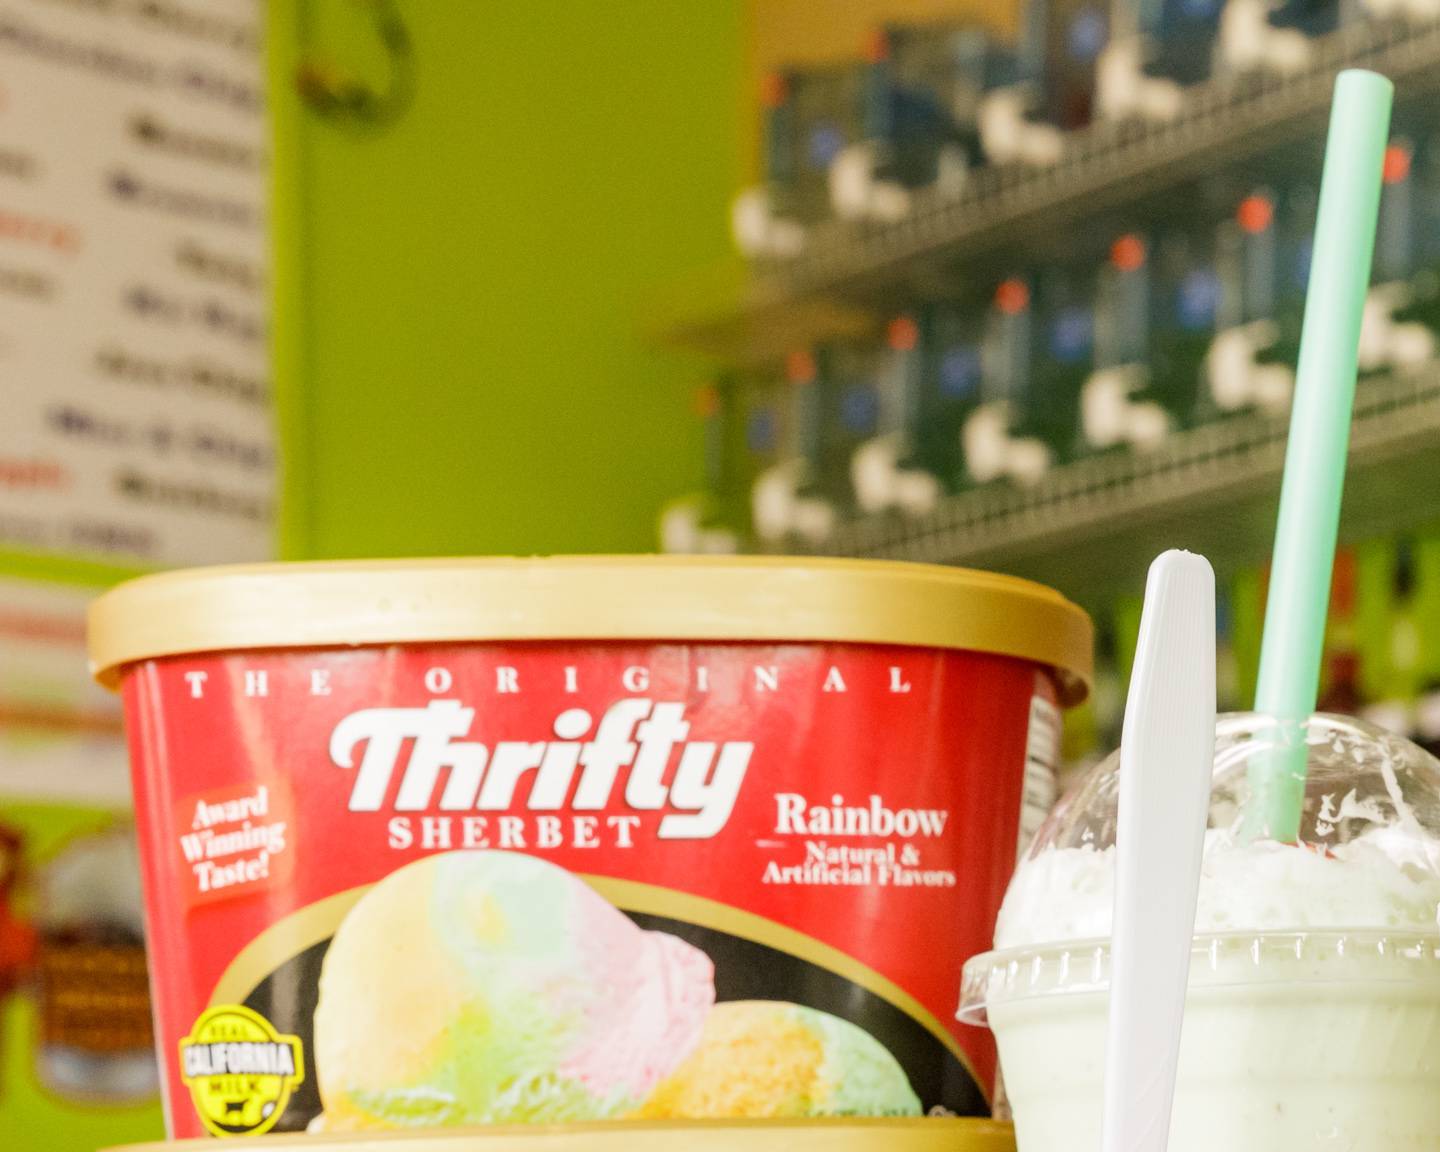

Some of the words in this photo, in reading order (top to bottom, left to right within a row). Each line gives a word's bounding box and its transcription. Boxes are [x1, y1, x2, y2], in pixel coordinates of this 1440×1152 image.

[185, 669, 331, 698] THE
[425, 666, 911, 694] ORIGINAL
[329, 699, 754, 839] Thrifty
[192, 785, 268, 830] Award
[775, 793, 948, 837] Rainbow
[181, 821, 287, 864] Winning
[388, 815, 641, 850] SHERBET
[806, 840, 896, 865] Natural
[901, 843, 920, 866] &
[193, 849, 269, 892] Taste!
[762, 861, 871, 884] Artificial
[878, 863, 957, 887] Flavors
